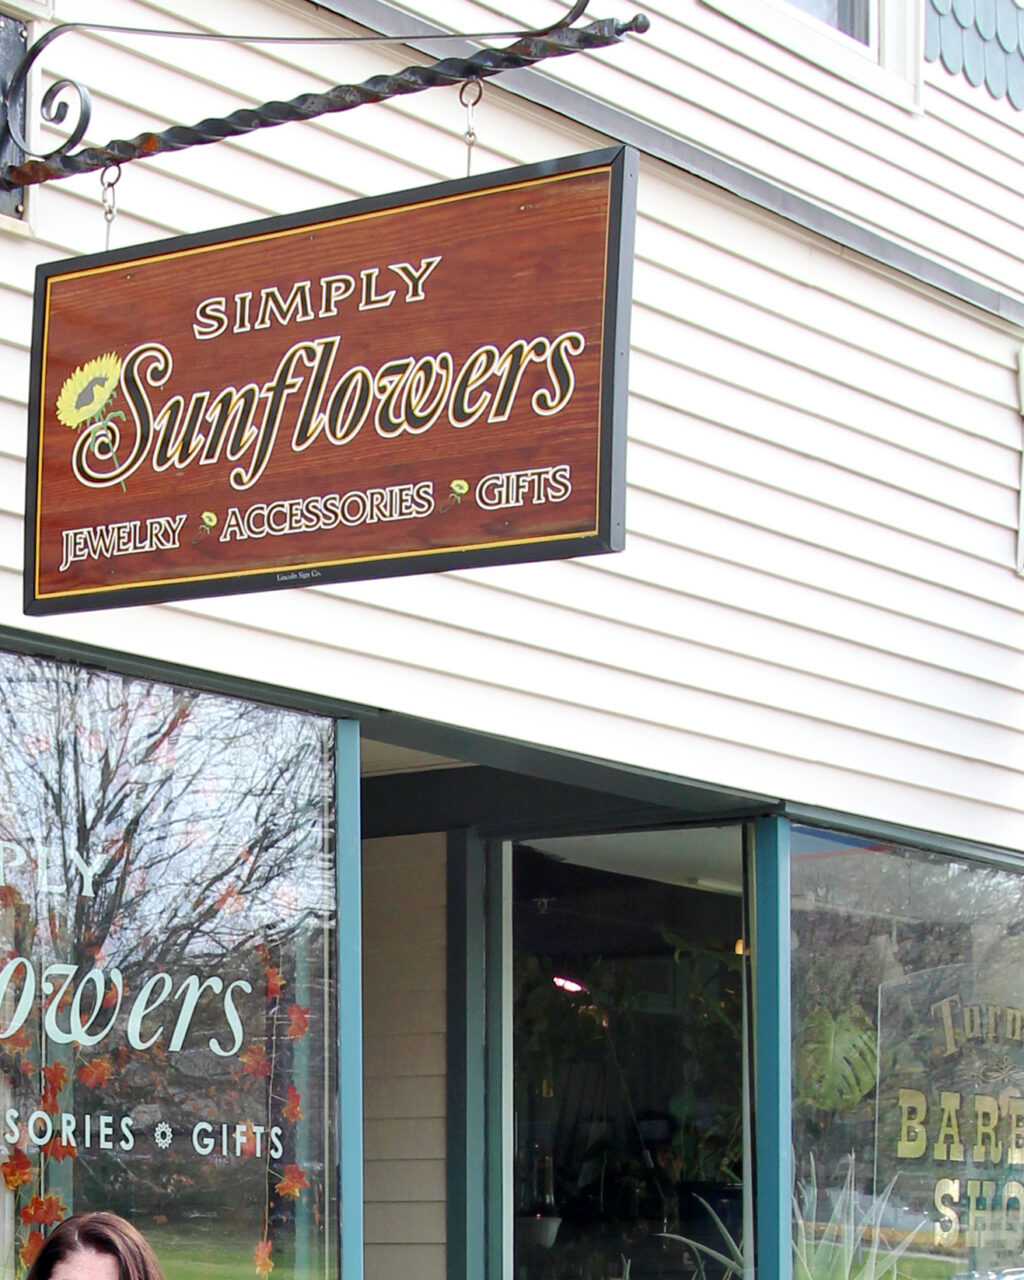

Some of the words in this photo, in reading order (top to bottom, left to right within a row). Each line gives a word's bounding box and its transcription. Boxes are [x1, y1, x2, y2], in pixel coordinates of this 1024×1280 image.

[193, 256, 442, 340] SIMPLY
[72, 330, 585, 490] Sunflowers
[60, 514, 187, 571] JEWELRY
[220, 482, 435, 542] ACCESSORIES
[476, 465, 572, 510] GIFTS
[192, 1122, 284, 1159] GIFTS
